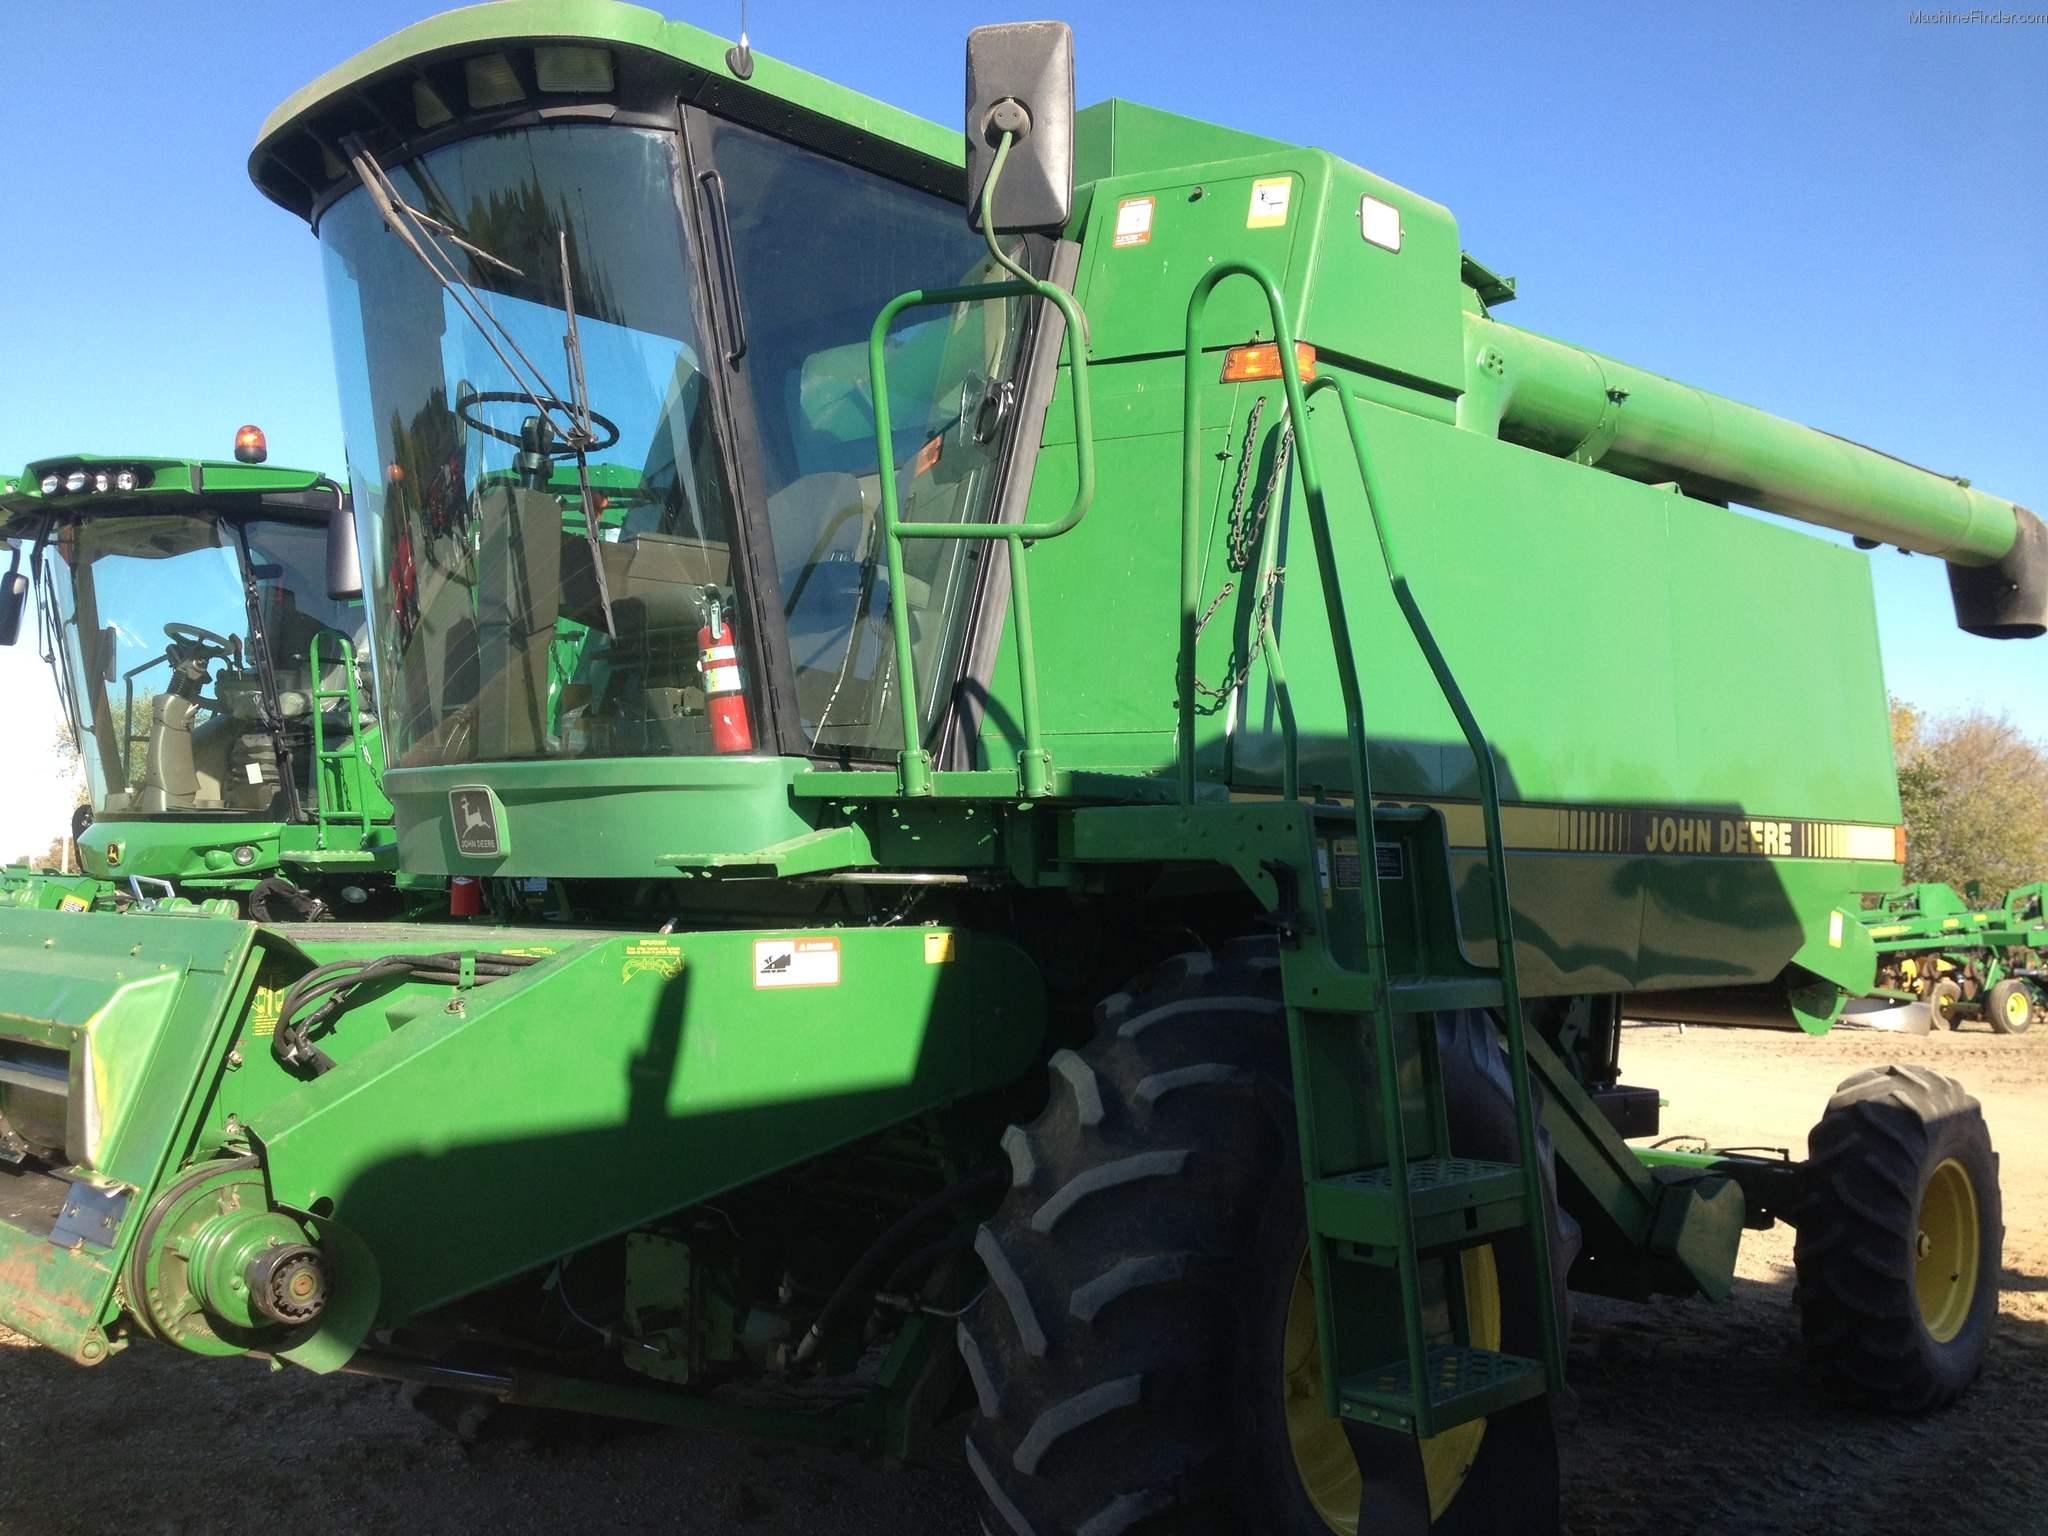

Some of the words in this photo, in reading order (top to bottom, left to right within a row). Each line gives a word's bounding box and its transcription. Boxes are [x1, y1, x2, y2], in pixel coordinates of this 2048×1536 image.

[461, 839, 477, 848] JOHN
[477, 839, 496, 848] DEERE
[1645, 816, 1712, 853] JOHN
[1720, 820, 1792, 855] DEERE
